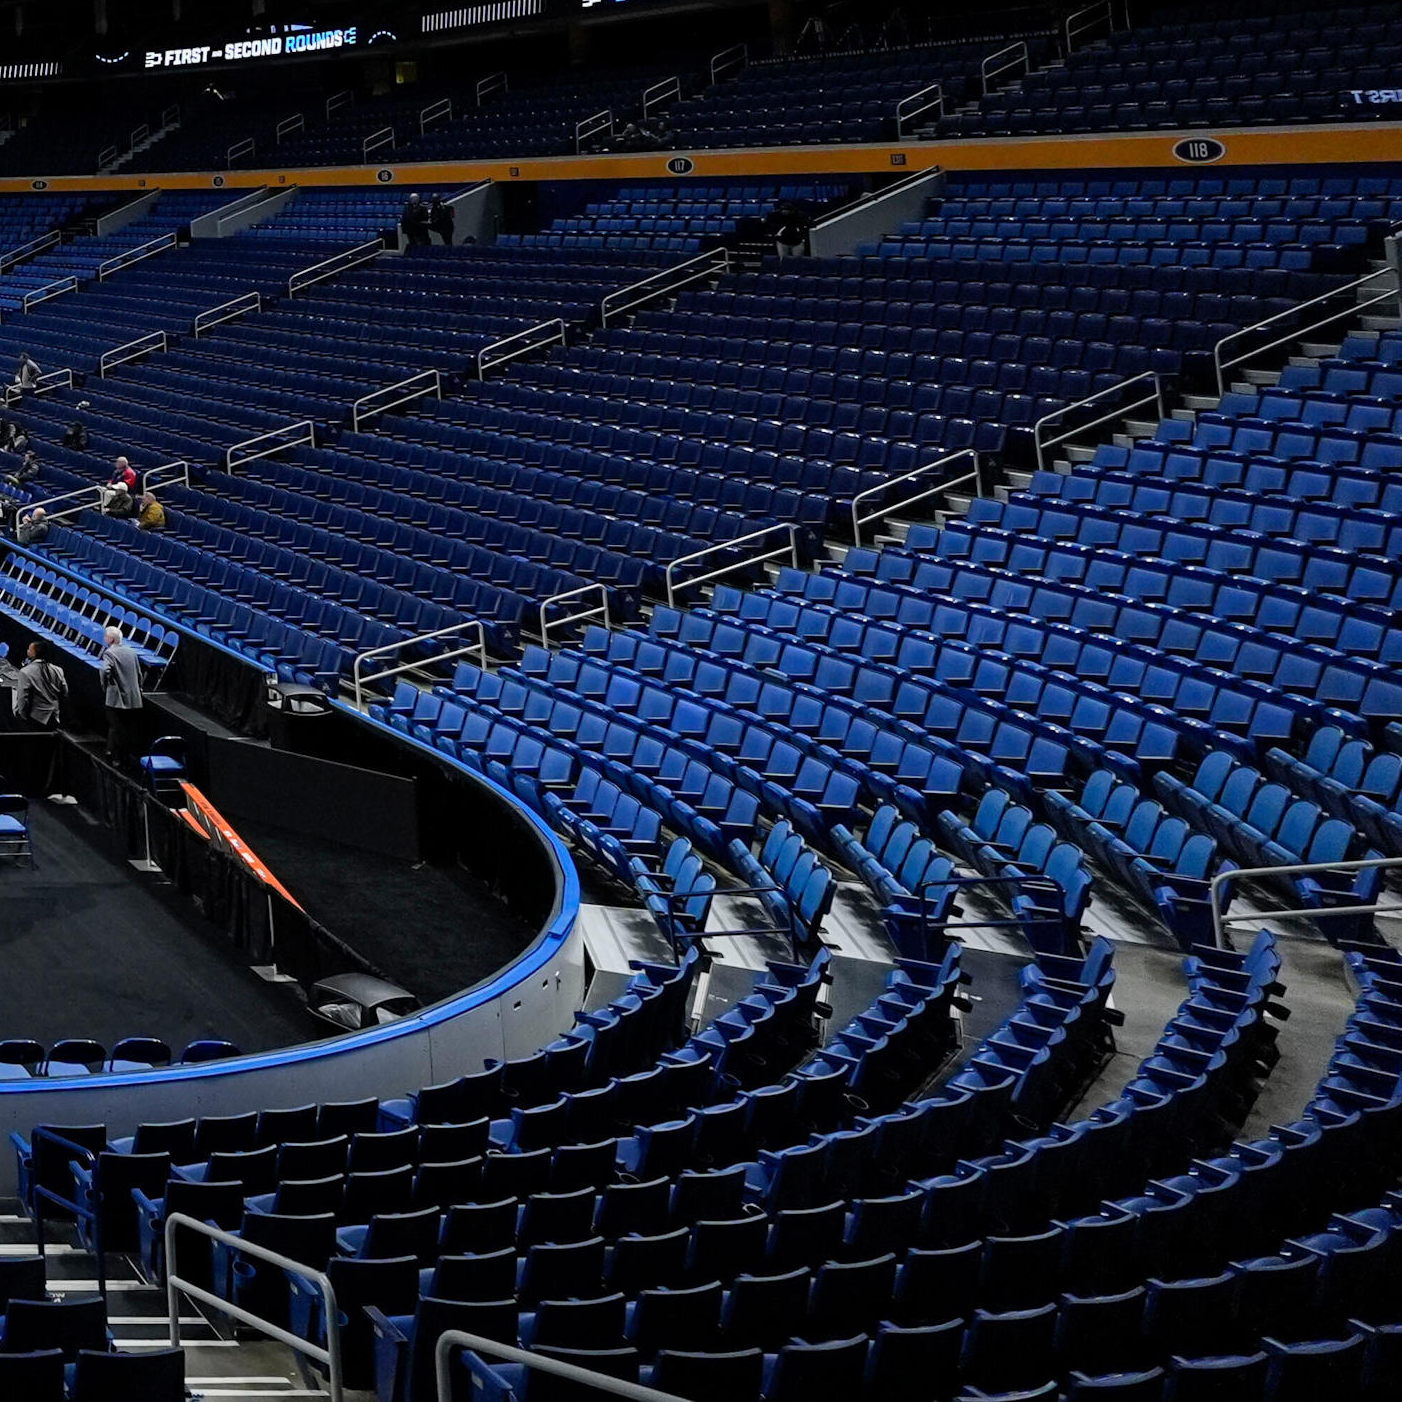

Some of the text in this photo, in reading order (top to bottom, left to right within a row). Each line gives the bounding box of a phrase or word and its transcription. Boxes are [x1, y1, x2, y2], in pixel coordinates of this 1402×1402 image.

[164, 29, 343, 66] FIRST SECOND ROUNDS
[1189, 142, 1209, 159] 118
